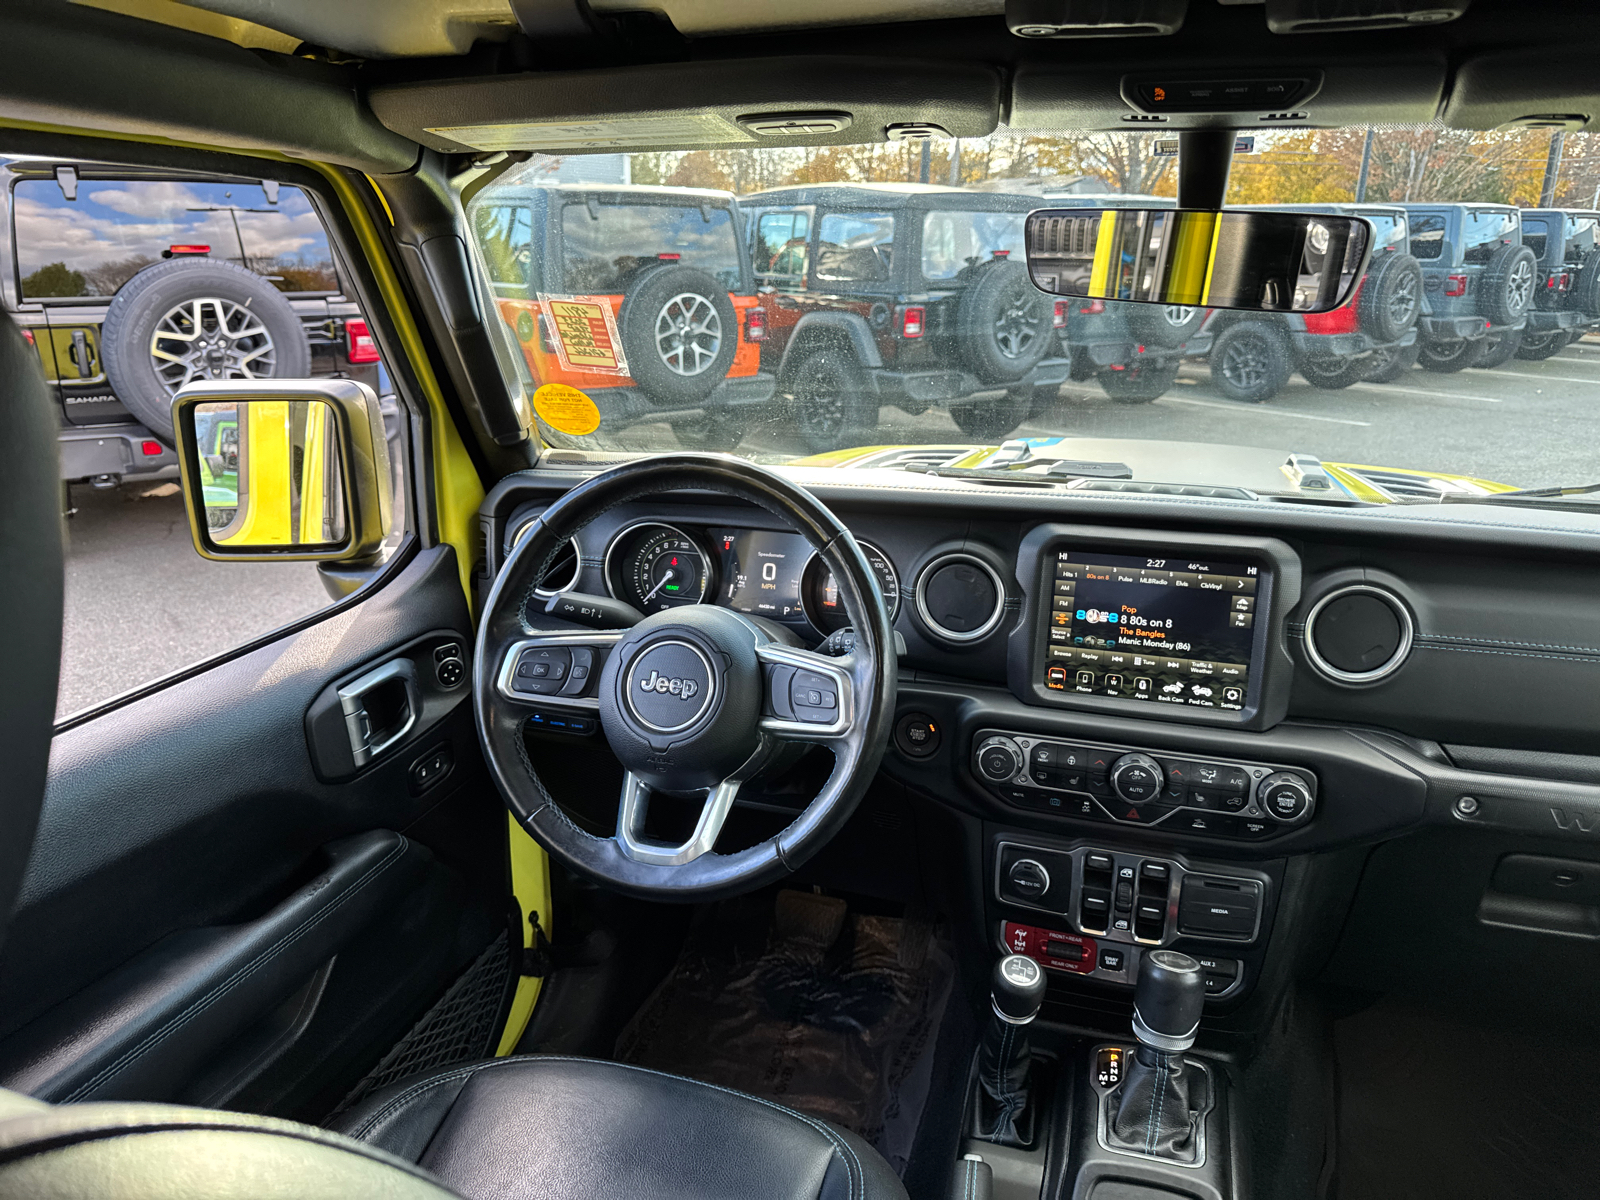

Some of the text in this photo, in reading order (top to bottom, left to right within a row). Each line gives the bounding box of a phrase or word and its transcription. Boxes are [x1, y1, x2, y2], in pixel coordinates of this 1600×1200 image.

[65, 395, 116, 404] SAHARA
[1146, 559, 1166, 568] 2:27
[762, 562, 776, 581] 0
[1247, 566, 1258, 575] HI
[784, 606, 790, 615] P
[1121, 605, 1137, 614] Pop
[1120, 615, 1128, 624] 8
[1130, 616, 1147, 626] 80s
[1165, 619, 1173, 628] 8
[1119, 627, 1165, 639] The Bangles
[1118, 636, 1141, 646] Manic
[1143, 639, 1174, 650] Monday
[1176, 643, 1191, 651] (86)
[640, 670, 698, 700] Jeep
